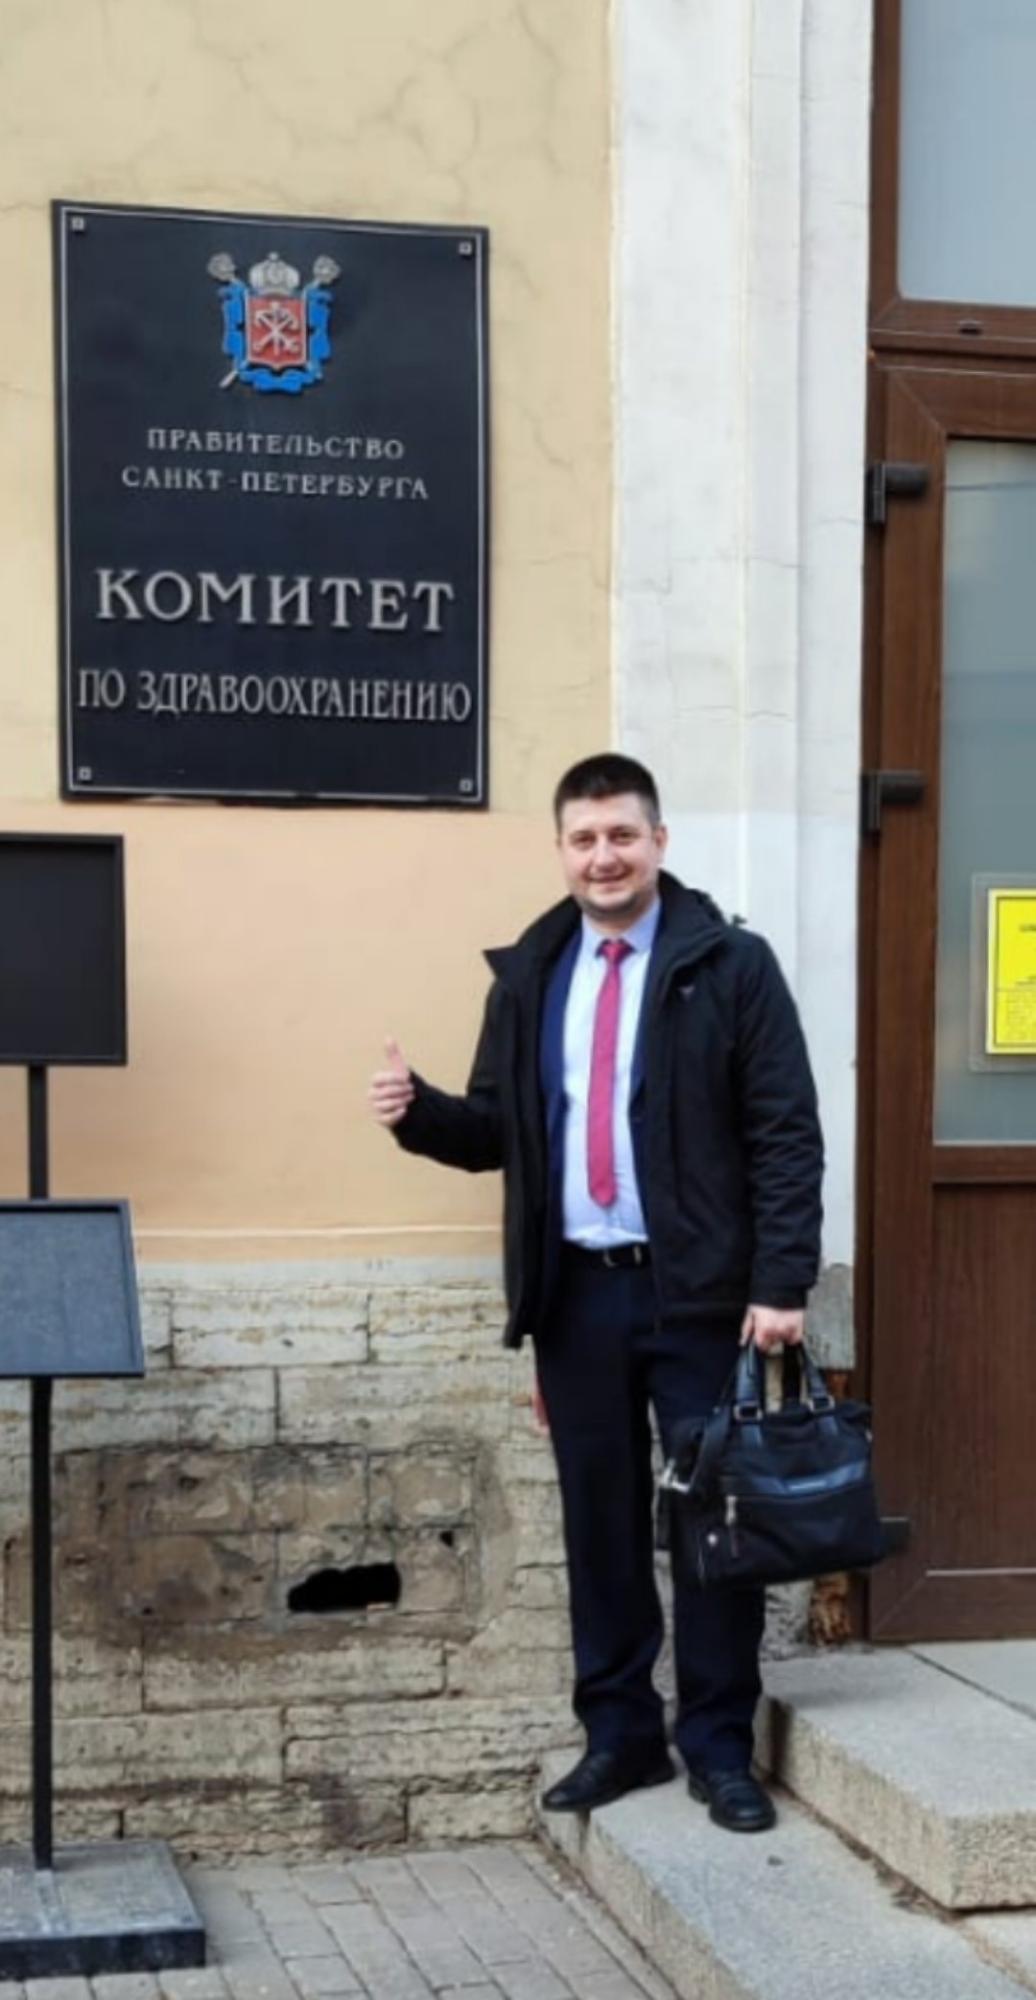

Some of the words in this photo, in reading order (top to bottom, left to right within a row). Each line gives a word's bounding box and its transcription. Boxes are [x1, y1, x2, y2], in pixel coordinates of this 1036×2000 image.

[147, 428, 406, 460] ПРАВИТЕЛЬСТВО
[121, 466, 429, 500] САНКТ-ПЕТЕРБУРГА
[95, 568, 455, 632] КОМИТЕТ
[77, 669, 125, 709] ПО
[137, 670, 471, 722] ЗДРАВООХРАНЕНИЮ
